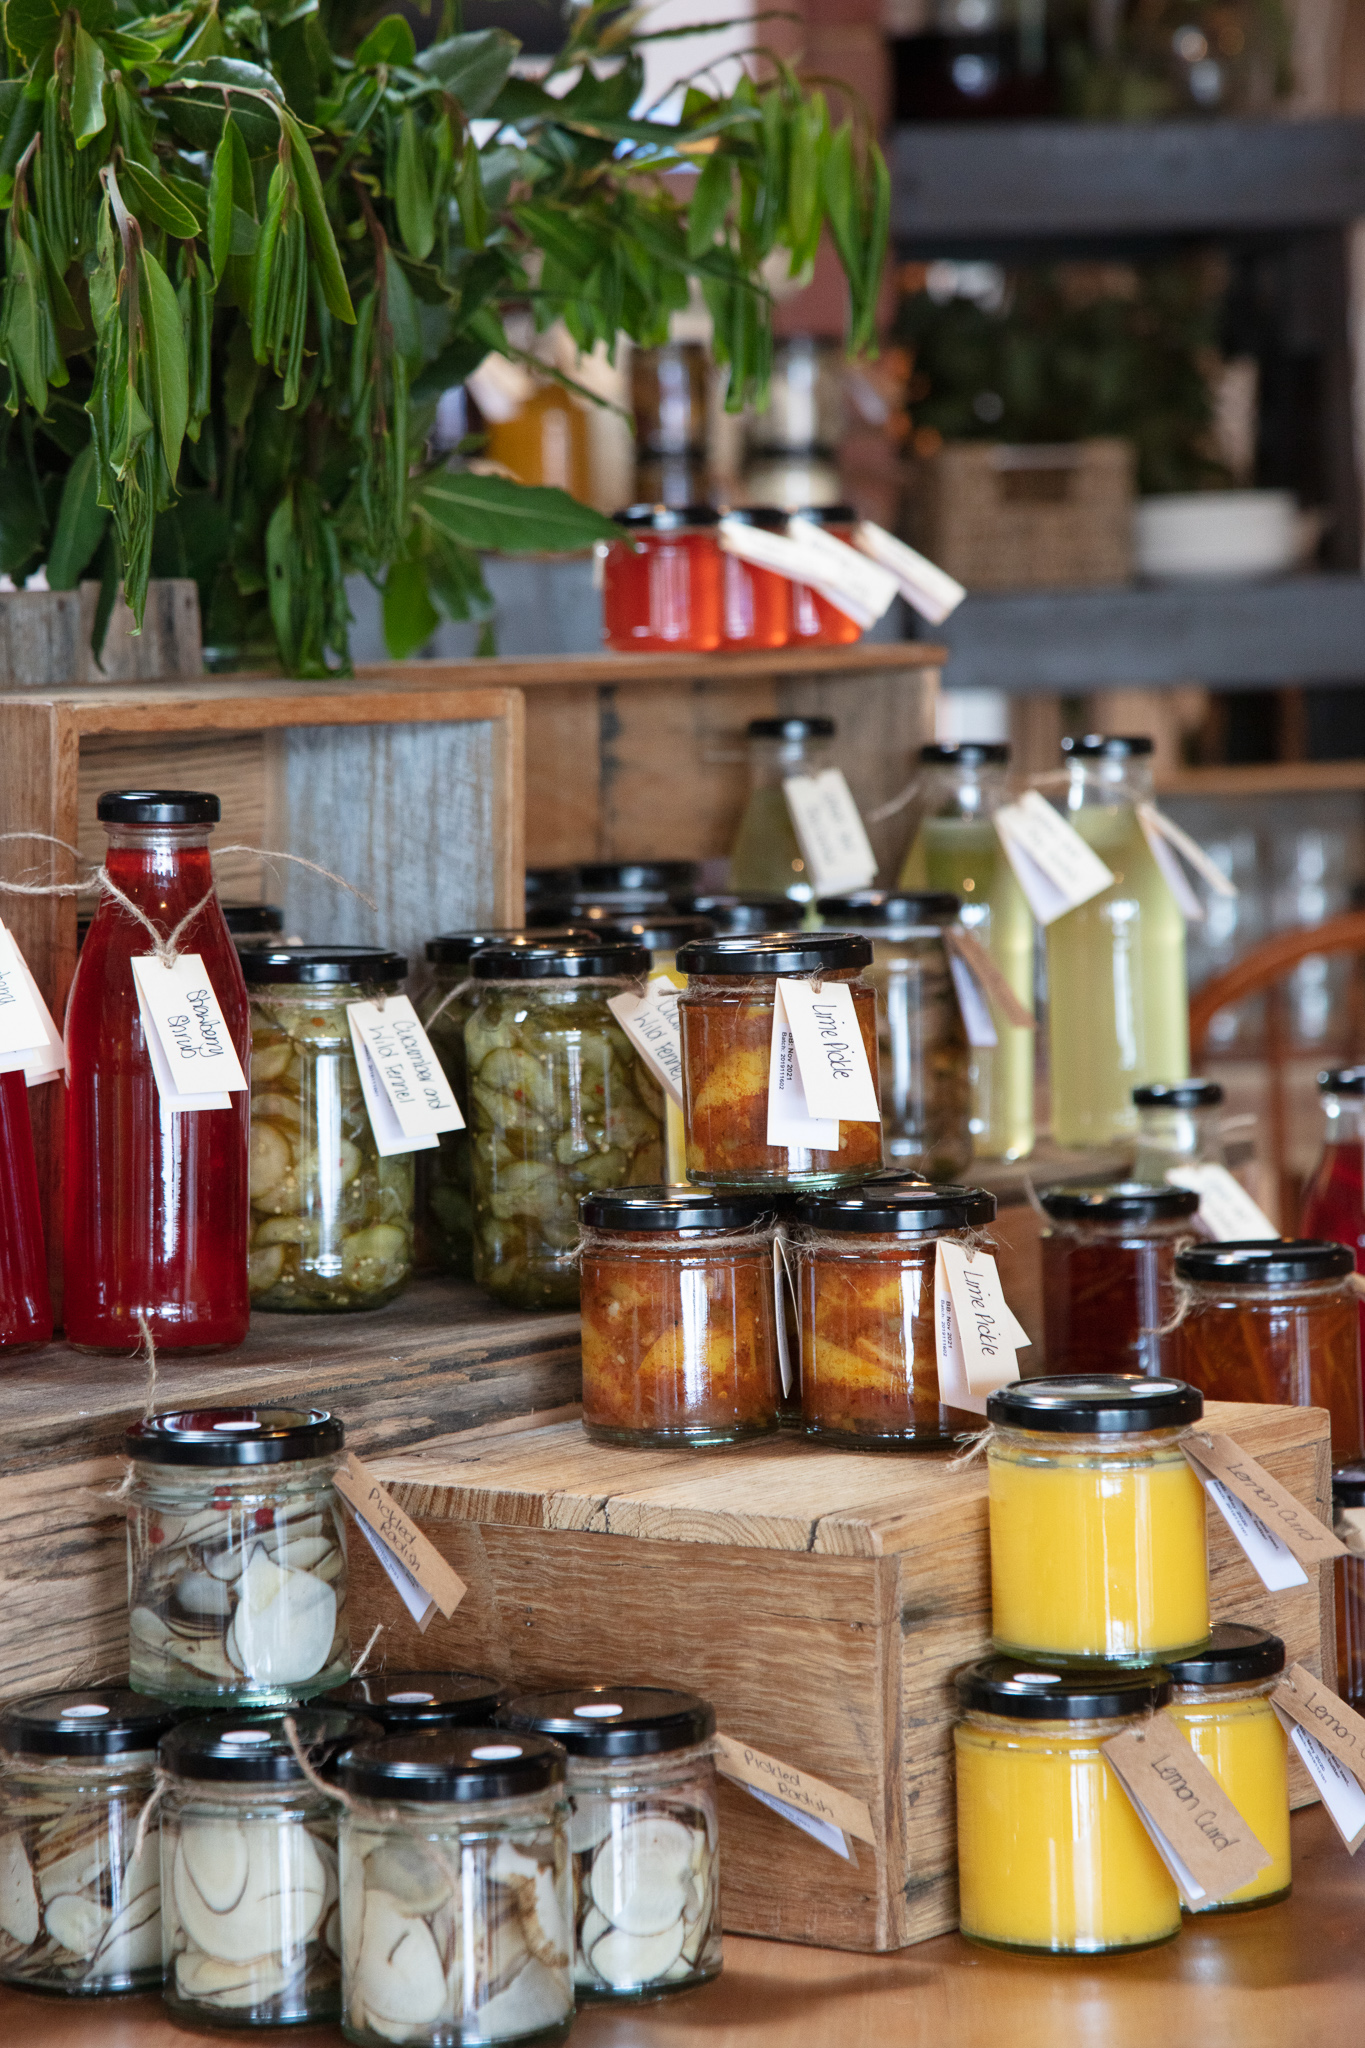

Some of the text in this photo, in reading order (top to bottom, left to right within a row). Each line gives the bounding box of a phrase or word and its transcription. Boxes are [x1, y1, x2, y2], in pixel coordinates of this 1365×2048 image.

[168, 1015, 203, 1059] Shrub
[634, 1012, 668, 1042] Wild
[812, 1005, 855, 1080] Lime Pickle
[369, 1025, 416, 1104] Wild Fennel
[393, 1021, 452, 1111] Cucumber and
[779, 1054, 787, 1091] 2019111602
[786, 1064, 794, 1082] 2021
[963, 1271, 1002, 1357] Lime Pickle
[368, 1487, 417, 1545] Pickled
[1226, 1463, 1324, 1542] Lemon Curd
[380, 1522, 421, 1572] Radish
[1305, 1692, 1357, 1748] Lemon
[744, 1750, 800, 1787] Pickled
[1316, 1753, 1326, 1772] 2020
[778, 1782, 835, 1819] Radish
[1151, 1754, 1242, 1853] Lemon Curd
